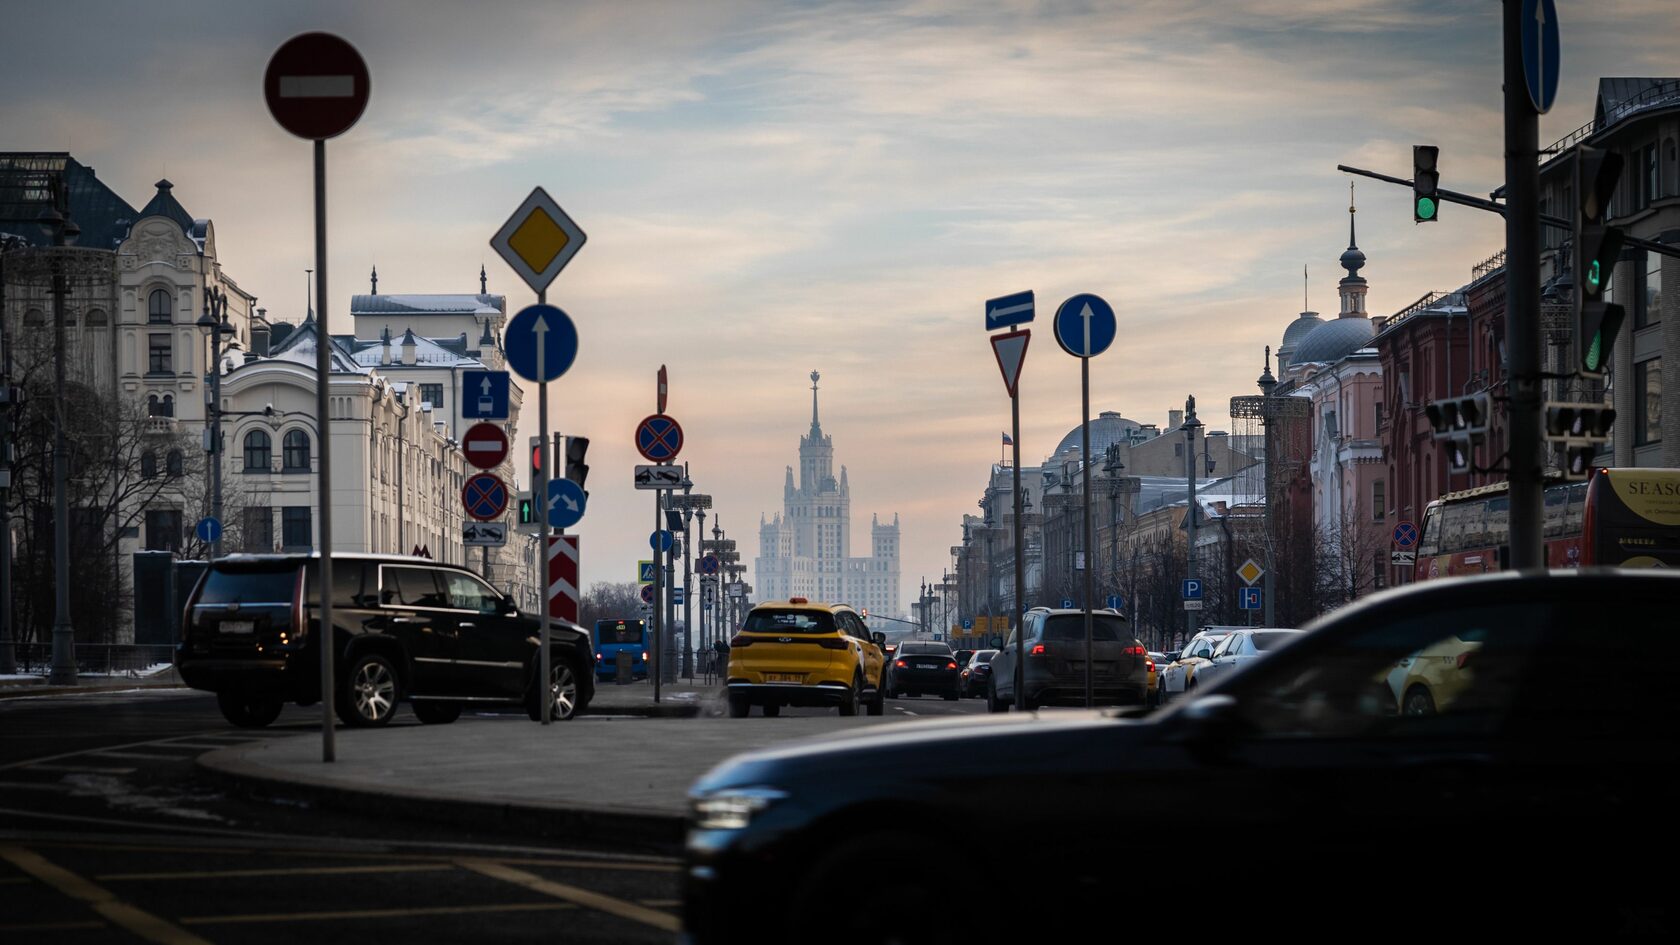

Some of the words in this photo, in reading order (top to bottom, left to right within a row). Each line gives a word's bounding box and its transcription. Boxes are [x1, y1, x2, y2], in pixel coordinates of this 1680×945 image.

[1188, 581, 1199, 596] P
[1064, 600, 1072, 609] P
[965, 620, 970, 628] P
